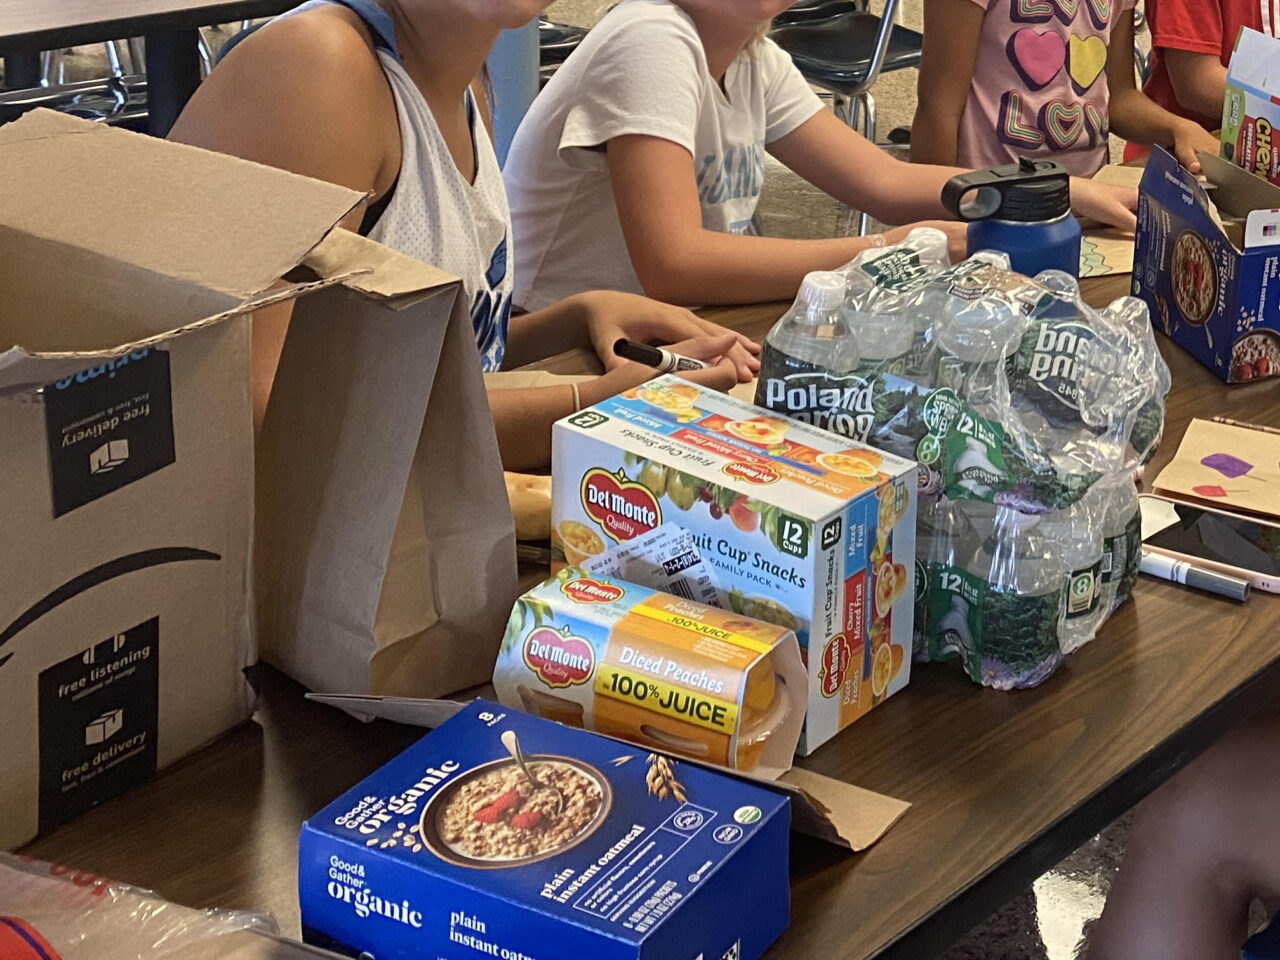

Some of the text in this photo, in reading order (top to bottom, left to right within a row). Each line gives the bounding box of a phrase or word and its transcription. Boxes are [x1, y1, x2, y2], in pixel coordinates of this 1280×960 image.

[1217, 249, 1228, 316] organic
[1270, 257, 1278, 278] plain
[1258, 258, 1270, 322] instant oatmeal
[766, 378, 876, 414] Poland
[62, 404, 150, 448] free delivery
[614, 408, 663, 429] Mixed Fruit
[956, 412, 974, 436] 12
[619, 428, 715, 467] Fruit Cup Snacks
[683, 434, 707, 447] Fruit
[707, 440, 734, 457] Mixed
[588, 483, 656, 528] Del Monte
[606, 514, 635, 536] Quality
[782, 520, 803, 545] 12
[823, 525, 835, 545] 12
[848, 524, 857, 557] Mixed
[856, 523, 864, 548] Fruit
[782, 540, 802, 554] Cups
[709, 557, 772, 588] FAMILY PACK
[717, 539, 748, 564] Cup
[752, 552, 807, 589] Snacks
[569, 581, 618, 600] Del Monte
[824, 549, 835, 638] Fruit Cup Snacks
[939, 571, 961, 593] 12
[662, 603, 704, 621] Peaches
[677, 600, 706, 614] Diced
[847, 602, 855, 631] Cherry
[854, 583, 863, 640] Mixed Fruit
[671, 616, 732, 640] 100% JUICE
[529, 640, 590, 672] Del Monte
[543, 664, 569, 678] Quality
[619, 646, 724, 694] Diced Peaches
[829, 639, 840, 693] Del Monte
[58, 646, 150, 698] free listening
[611, 672, 660, 701] 100%
[658, 690, 728, 726] JUICE
[843, 678, 852, 705] Diced
[61, 731, 146, 782] free delivery
[334, 795, 378, 826] Good&
[359, 760, 461, 835] organic
[345, 798, 386, 830] Gather
[328, 867, 365, 889] Gather
[329, 855, 365, 878] Good&
[554, 824, 646, 904] instant oatmeal
[541, 867, 575, 899] plain
[327, 881, 423, 928] organic
[450, 911, 486, 934] plain
[450, 928, 499, 956] instant
